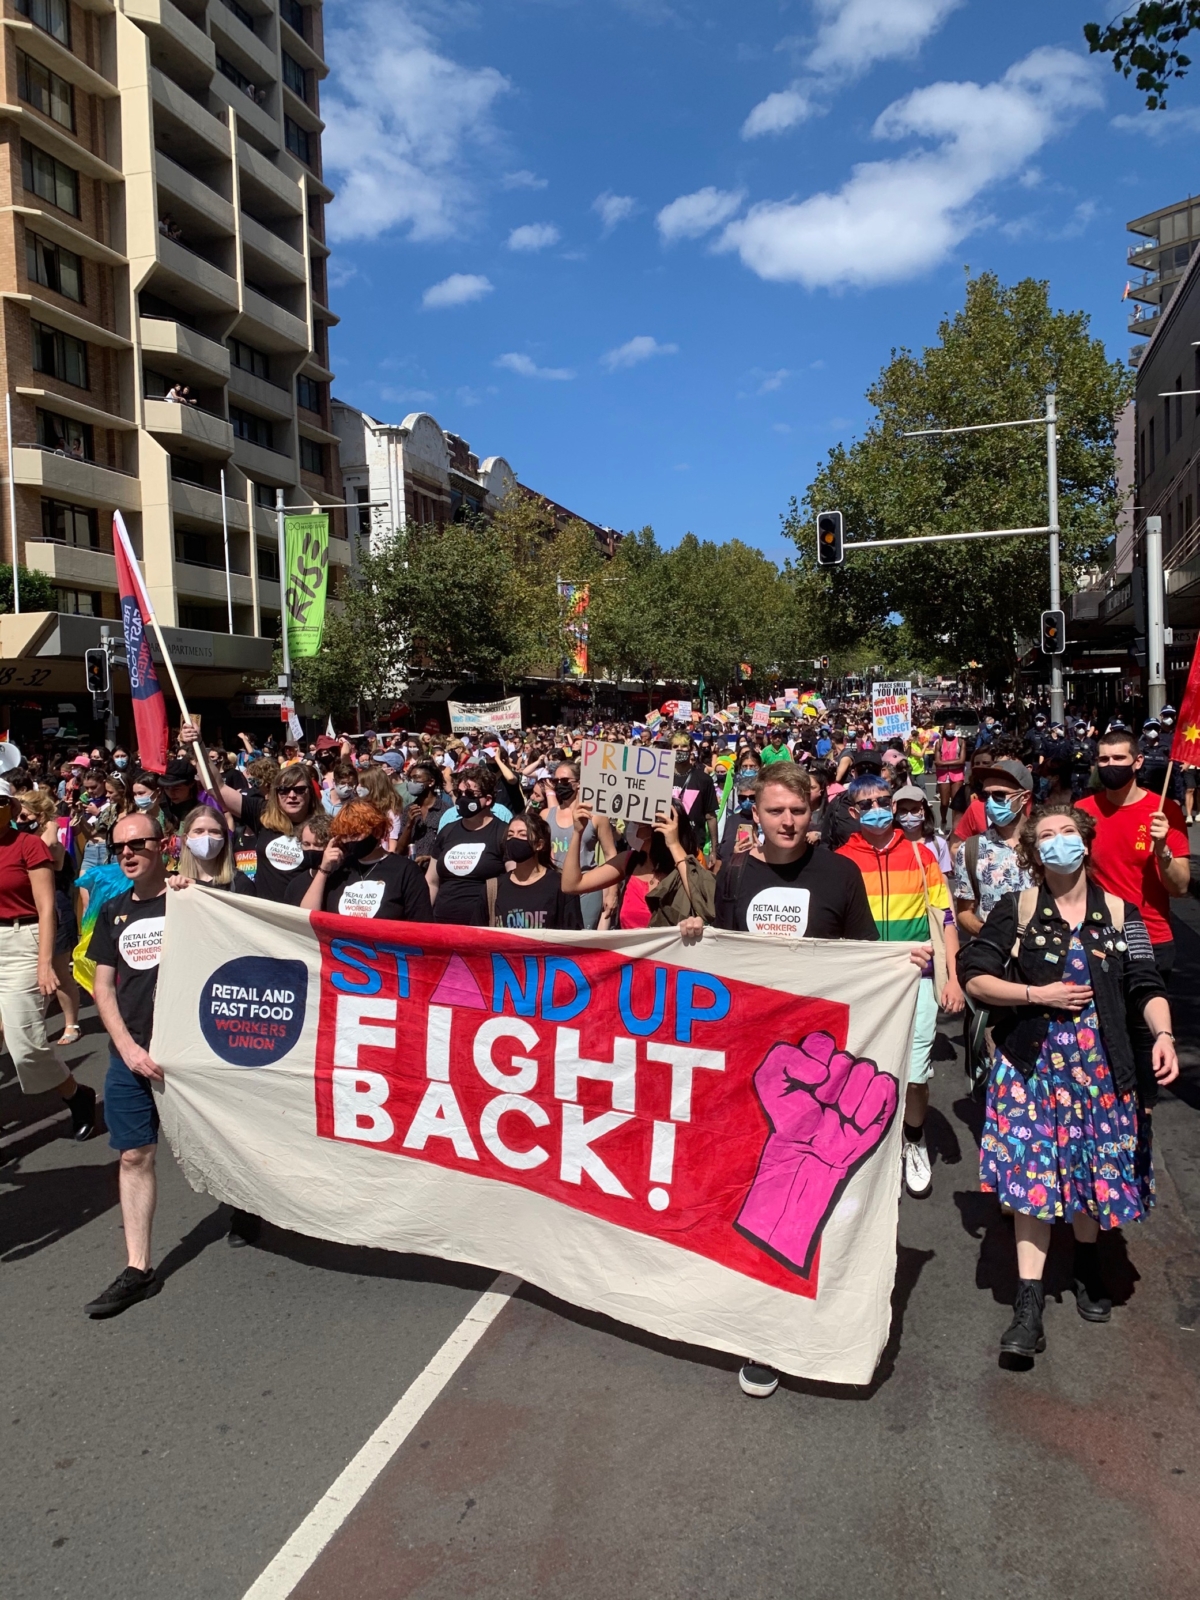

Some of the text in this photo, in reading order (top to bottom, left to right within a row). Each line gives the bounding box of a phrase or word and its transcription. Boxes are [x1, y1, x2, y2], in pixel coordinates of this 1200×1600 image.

[285, 532, 328, 624] RISE
[168, 644, 212, 658] APARTMENTS
[885, 696, 896, 706] NO
[874, 703, 910, 717] VIOLENCE
[886, 714, 900, 724] YES
[878, 722, 910, 736] RESPECT
[584, 740, 672, 779] PRIDE
[599, 772, 646, 790] TO THE
[582, 787, 667, 822] PEOPLE
[753, 904, 780, 912] RETAIL
[775, 915, 800, 923] FOOD
[756, 923, 797, 932] WORKERS
[123, 933, 147, 941] RETAIL
[123, 941, 141, 949] FAST
[126, 946, 162, 956] WORKERS
[132, 954, 157, 962] UNION
[212, 984, 294, 1004] RETAIL AND
[210, 1001, 293, 1020] FAST FOOD
[618, 964, 732, 1043] UP
[214, 1018, 287, 1038] WORKERS
[228, 1035, 275, 1050] UNION
[334, 994, 726, 1122] FIGHT
[332, 1067, 677, 1212] BACK!
